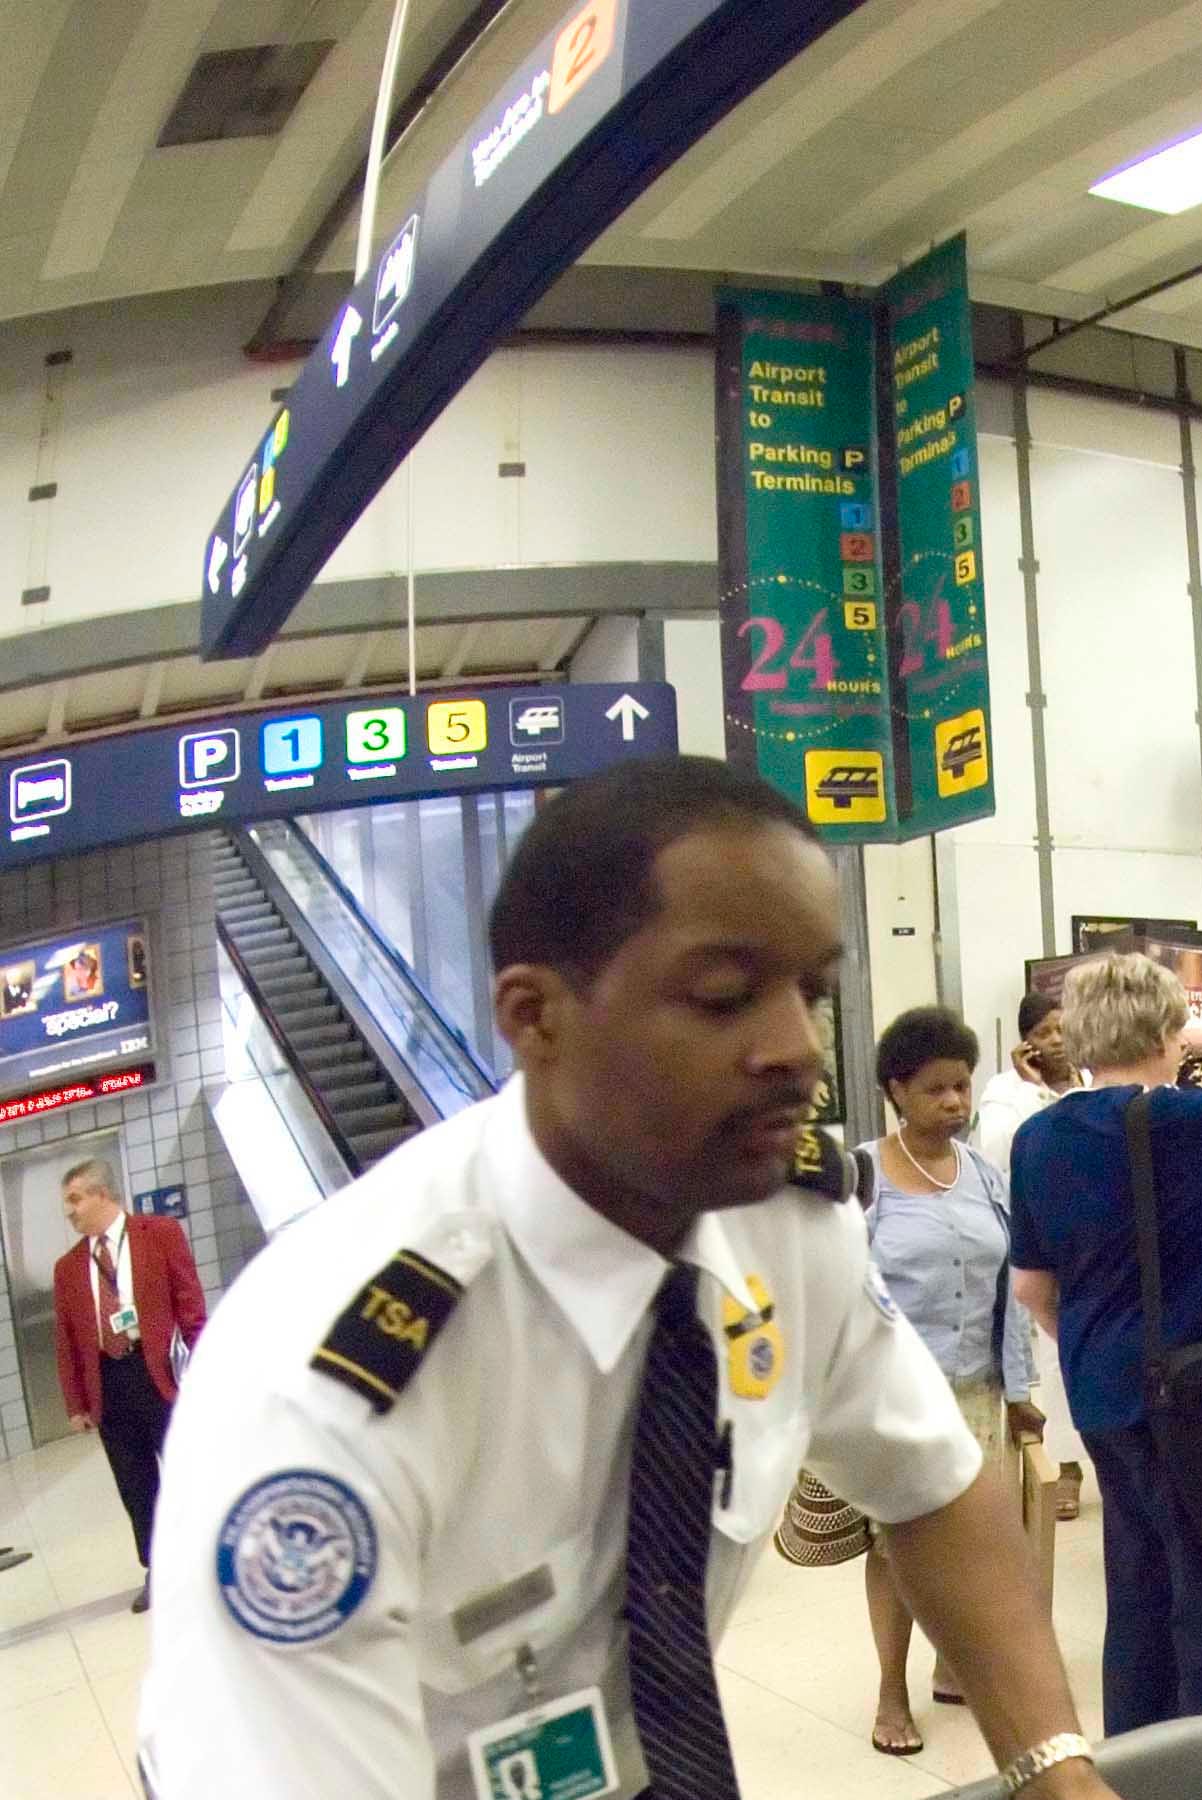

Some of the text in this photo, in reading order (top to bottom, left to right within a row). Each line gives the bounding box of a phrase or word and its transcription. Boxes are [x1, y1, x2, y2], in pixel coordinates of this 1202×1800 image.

[569, 15, 597, 86] 2
[749, 360, 827, 385] Airport
[749, 384, 824, 407] Transit
[948, 395, 962, 417] P
[749, 411, 772, 428] to
[749, 442, 866, 469] Parking P
[750, 470, 855, 495] Terminals
[956, 523, 967, 542] 3
[849, 538, 866, 556] 2
[958, 559, 969, 579] 5
[851, 571, 868, 591] 3
[852, 607, 870, 626] 5
[737, 607, 841, 691] 24
[827, 680, 881, 694] HOURS
[194, 711, 471, 779] P 1 3 5
[511, 752, 548, 764] Airport
[511, 762, 547, 774] Transit
[360, 1285, 430, 1351] TSA
